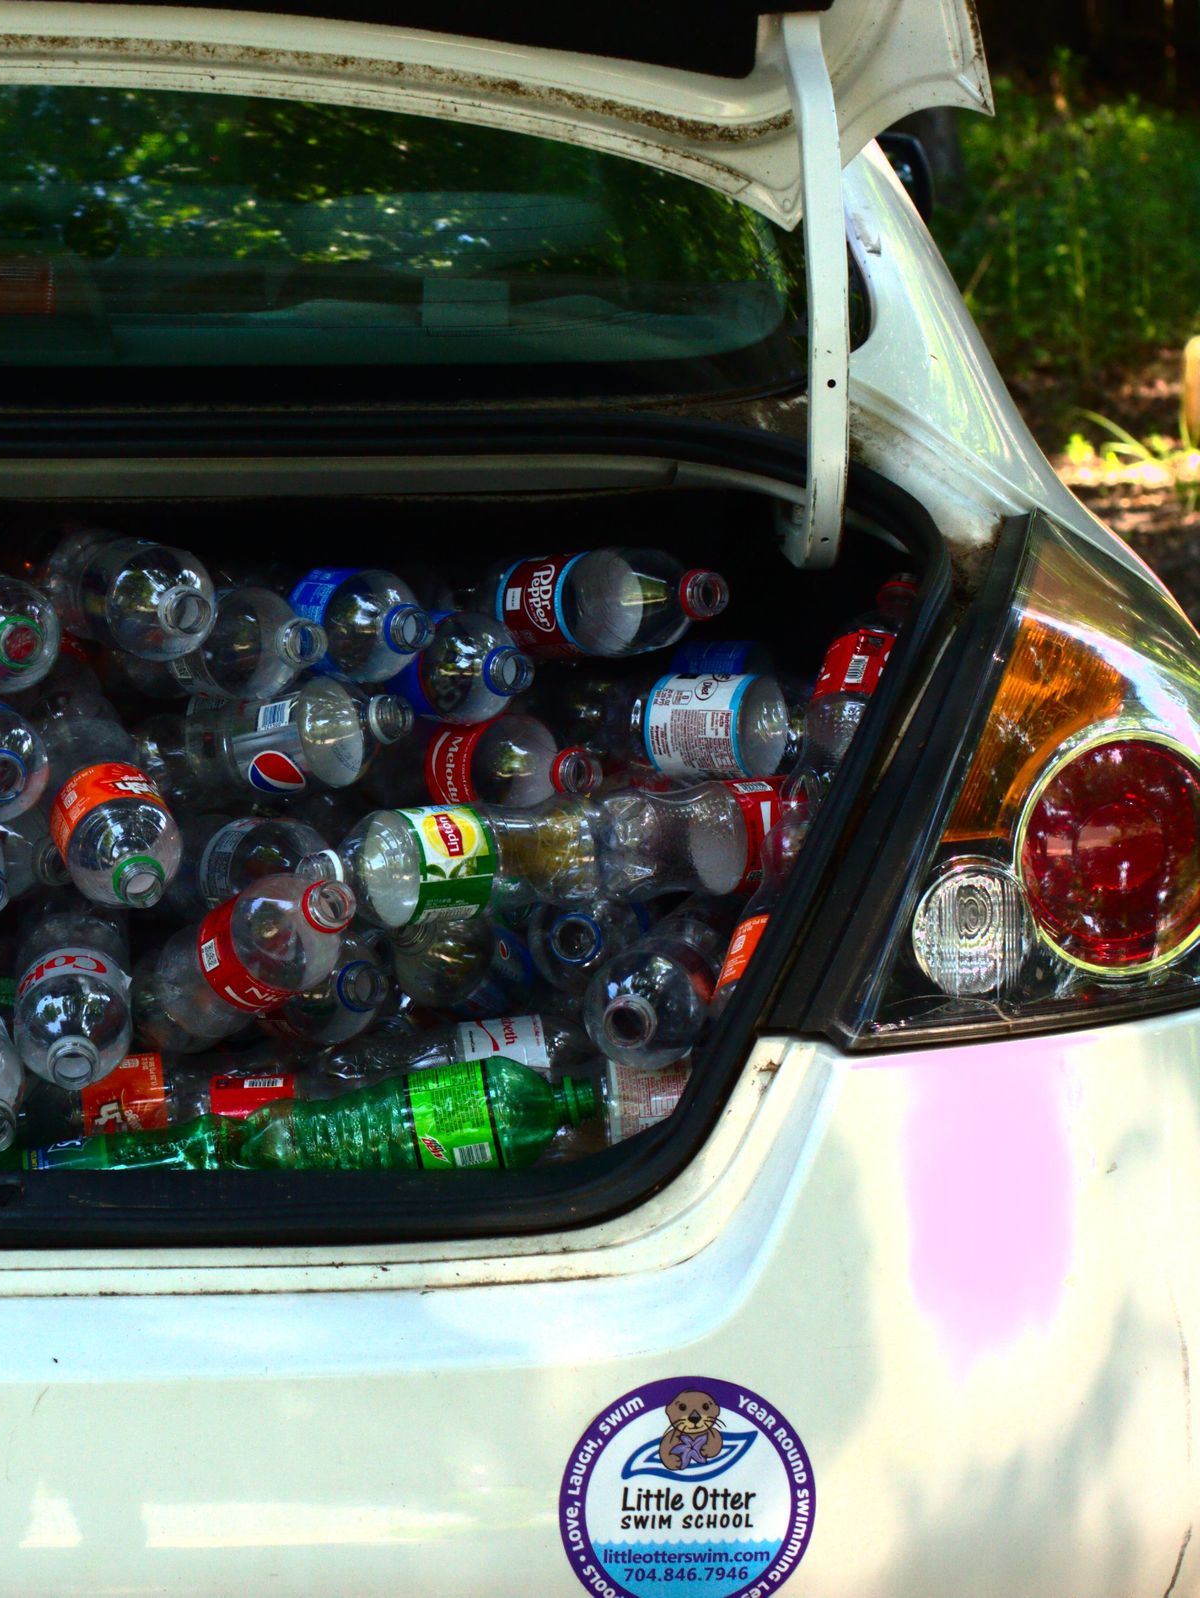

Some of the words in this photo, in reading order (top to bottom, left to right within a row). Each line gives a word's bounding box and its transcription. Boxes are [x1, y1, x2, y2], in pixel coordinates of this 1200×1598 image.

[528, 570, 554, 627] Pepper
[540, 585, 552, 610] Dr
[701, 682, 712, 695] Diet
[445, 736, 464, 802] Melody
[439, 815, 461, 853] Lipton
[621, 1486, 684, 1511] Little
[692, 1486, 756, 1511] Otter
[620, 1514, 672, 1530] SWIM
[682, 1513, 754, 1529] SCHOOL
[603, 1548, 770, 1564] littleotterswim.com
[623, 1566, 749, 1582] 704.846.7946
